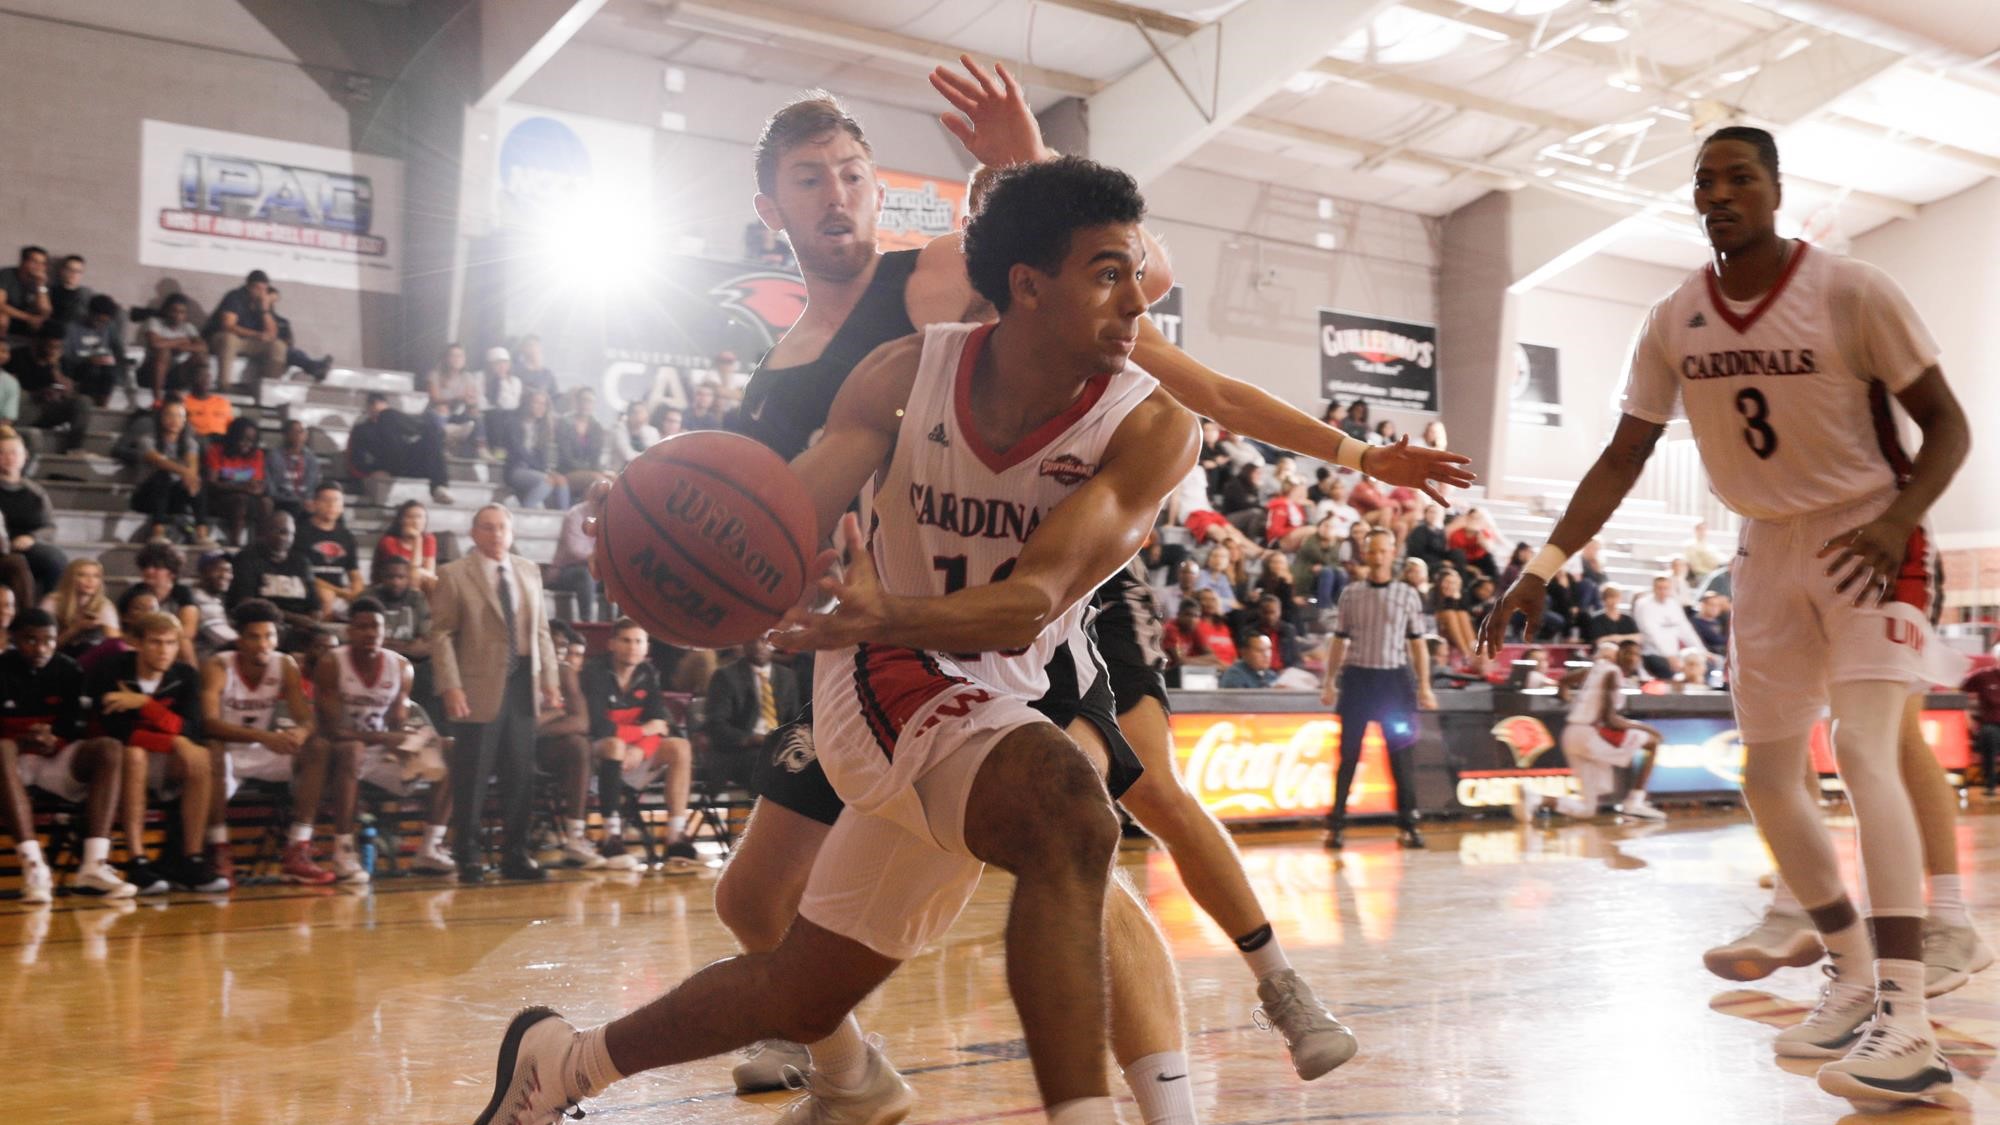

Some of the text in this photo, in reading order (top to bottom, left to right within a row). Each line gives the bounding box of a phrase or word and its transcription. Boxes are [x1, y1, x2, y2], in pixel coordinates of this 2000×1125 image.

[1682, 349, 1817, 380] CARDINALS
[1735, 387, 1778, 460] 3
[665, 477, 784, 594] Wilson
[909, 482, 1054, 543] CARDINA
